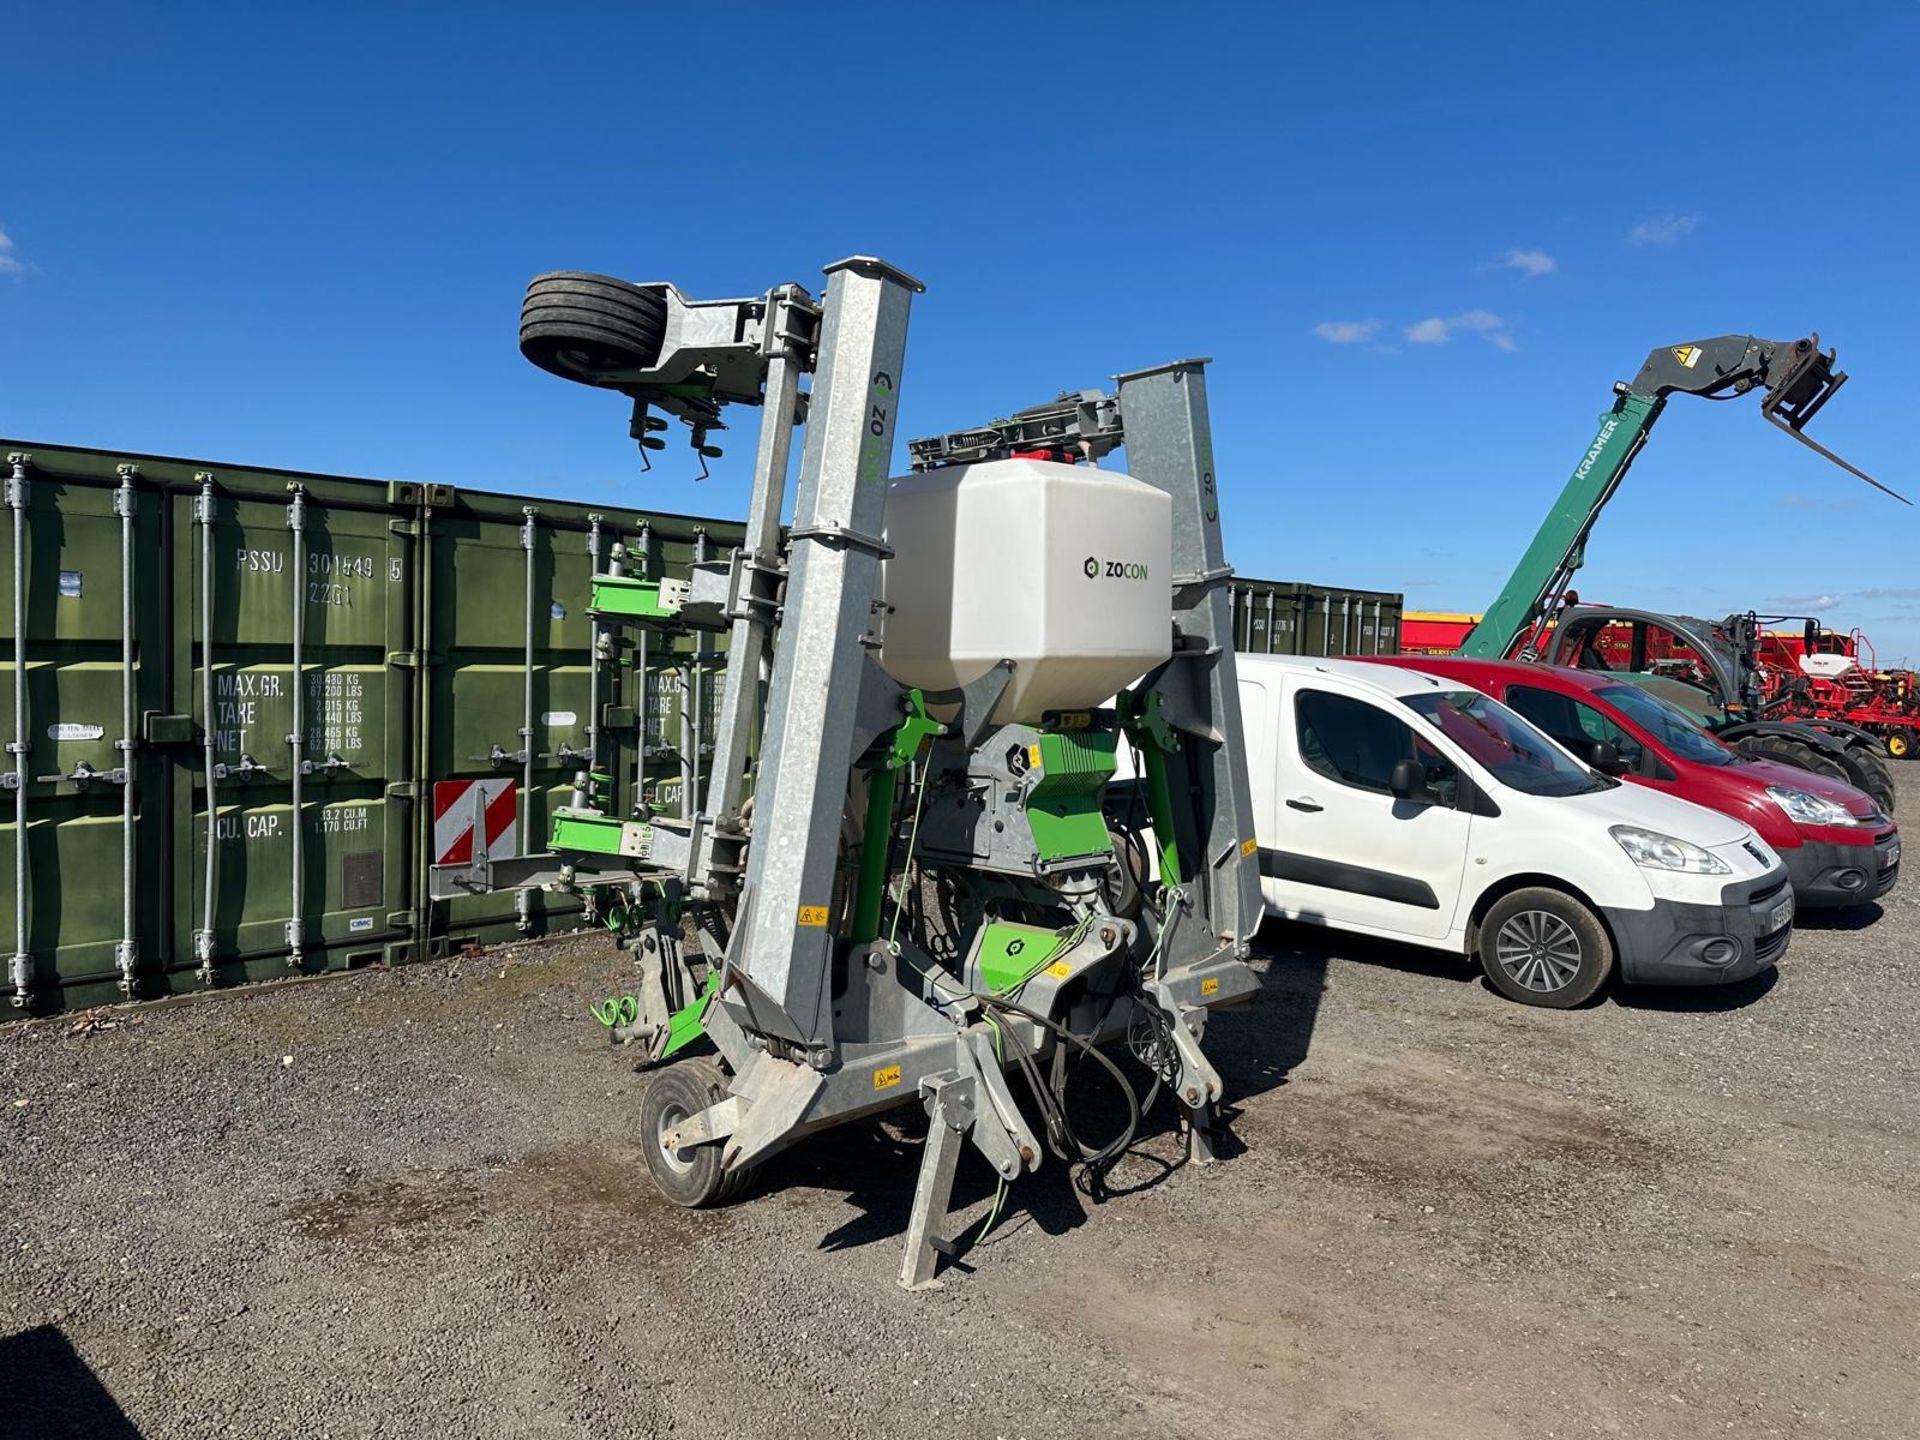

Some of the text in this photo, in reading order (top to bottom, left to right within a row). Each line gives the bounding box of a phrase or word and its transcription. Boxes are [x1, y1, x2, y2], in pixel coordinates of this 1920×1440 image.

[1575, 420, 1618, 480] KRAMER
[236, 549, 282, 573] PSSU
[390, 559, 401, 580] 5
[1106, 561, 1148, 580] ZOCON
[309, 582, 352, 606] 22G1
[217, 674, 284, 697] MAX.GR.
[346, 674, 359, 685] KG
[648, 675, 681, 693] MAX.G
[346, 685, 362, 697] LBS
[218, 702, 256, 724] TARE
[346, 700, 358, 711] KG
[648, 697, 672, 714] TARE
[346, 711, 362, 723] LBS
[346, 727, 358, 738] KG
[647, 718, 666, 737] NET
[217, 730, 247, 751] NET
[346, 738, 362, 749] LBS
[217, 815, 283, 839] CU. CAP.
